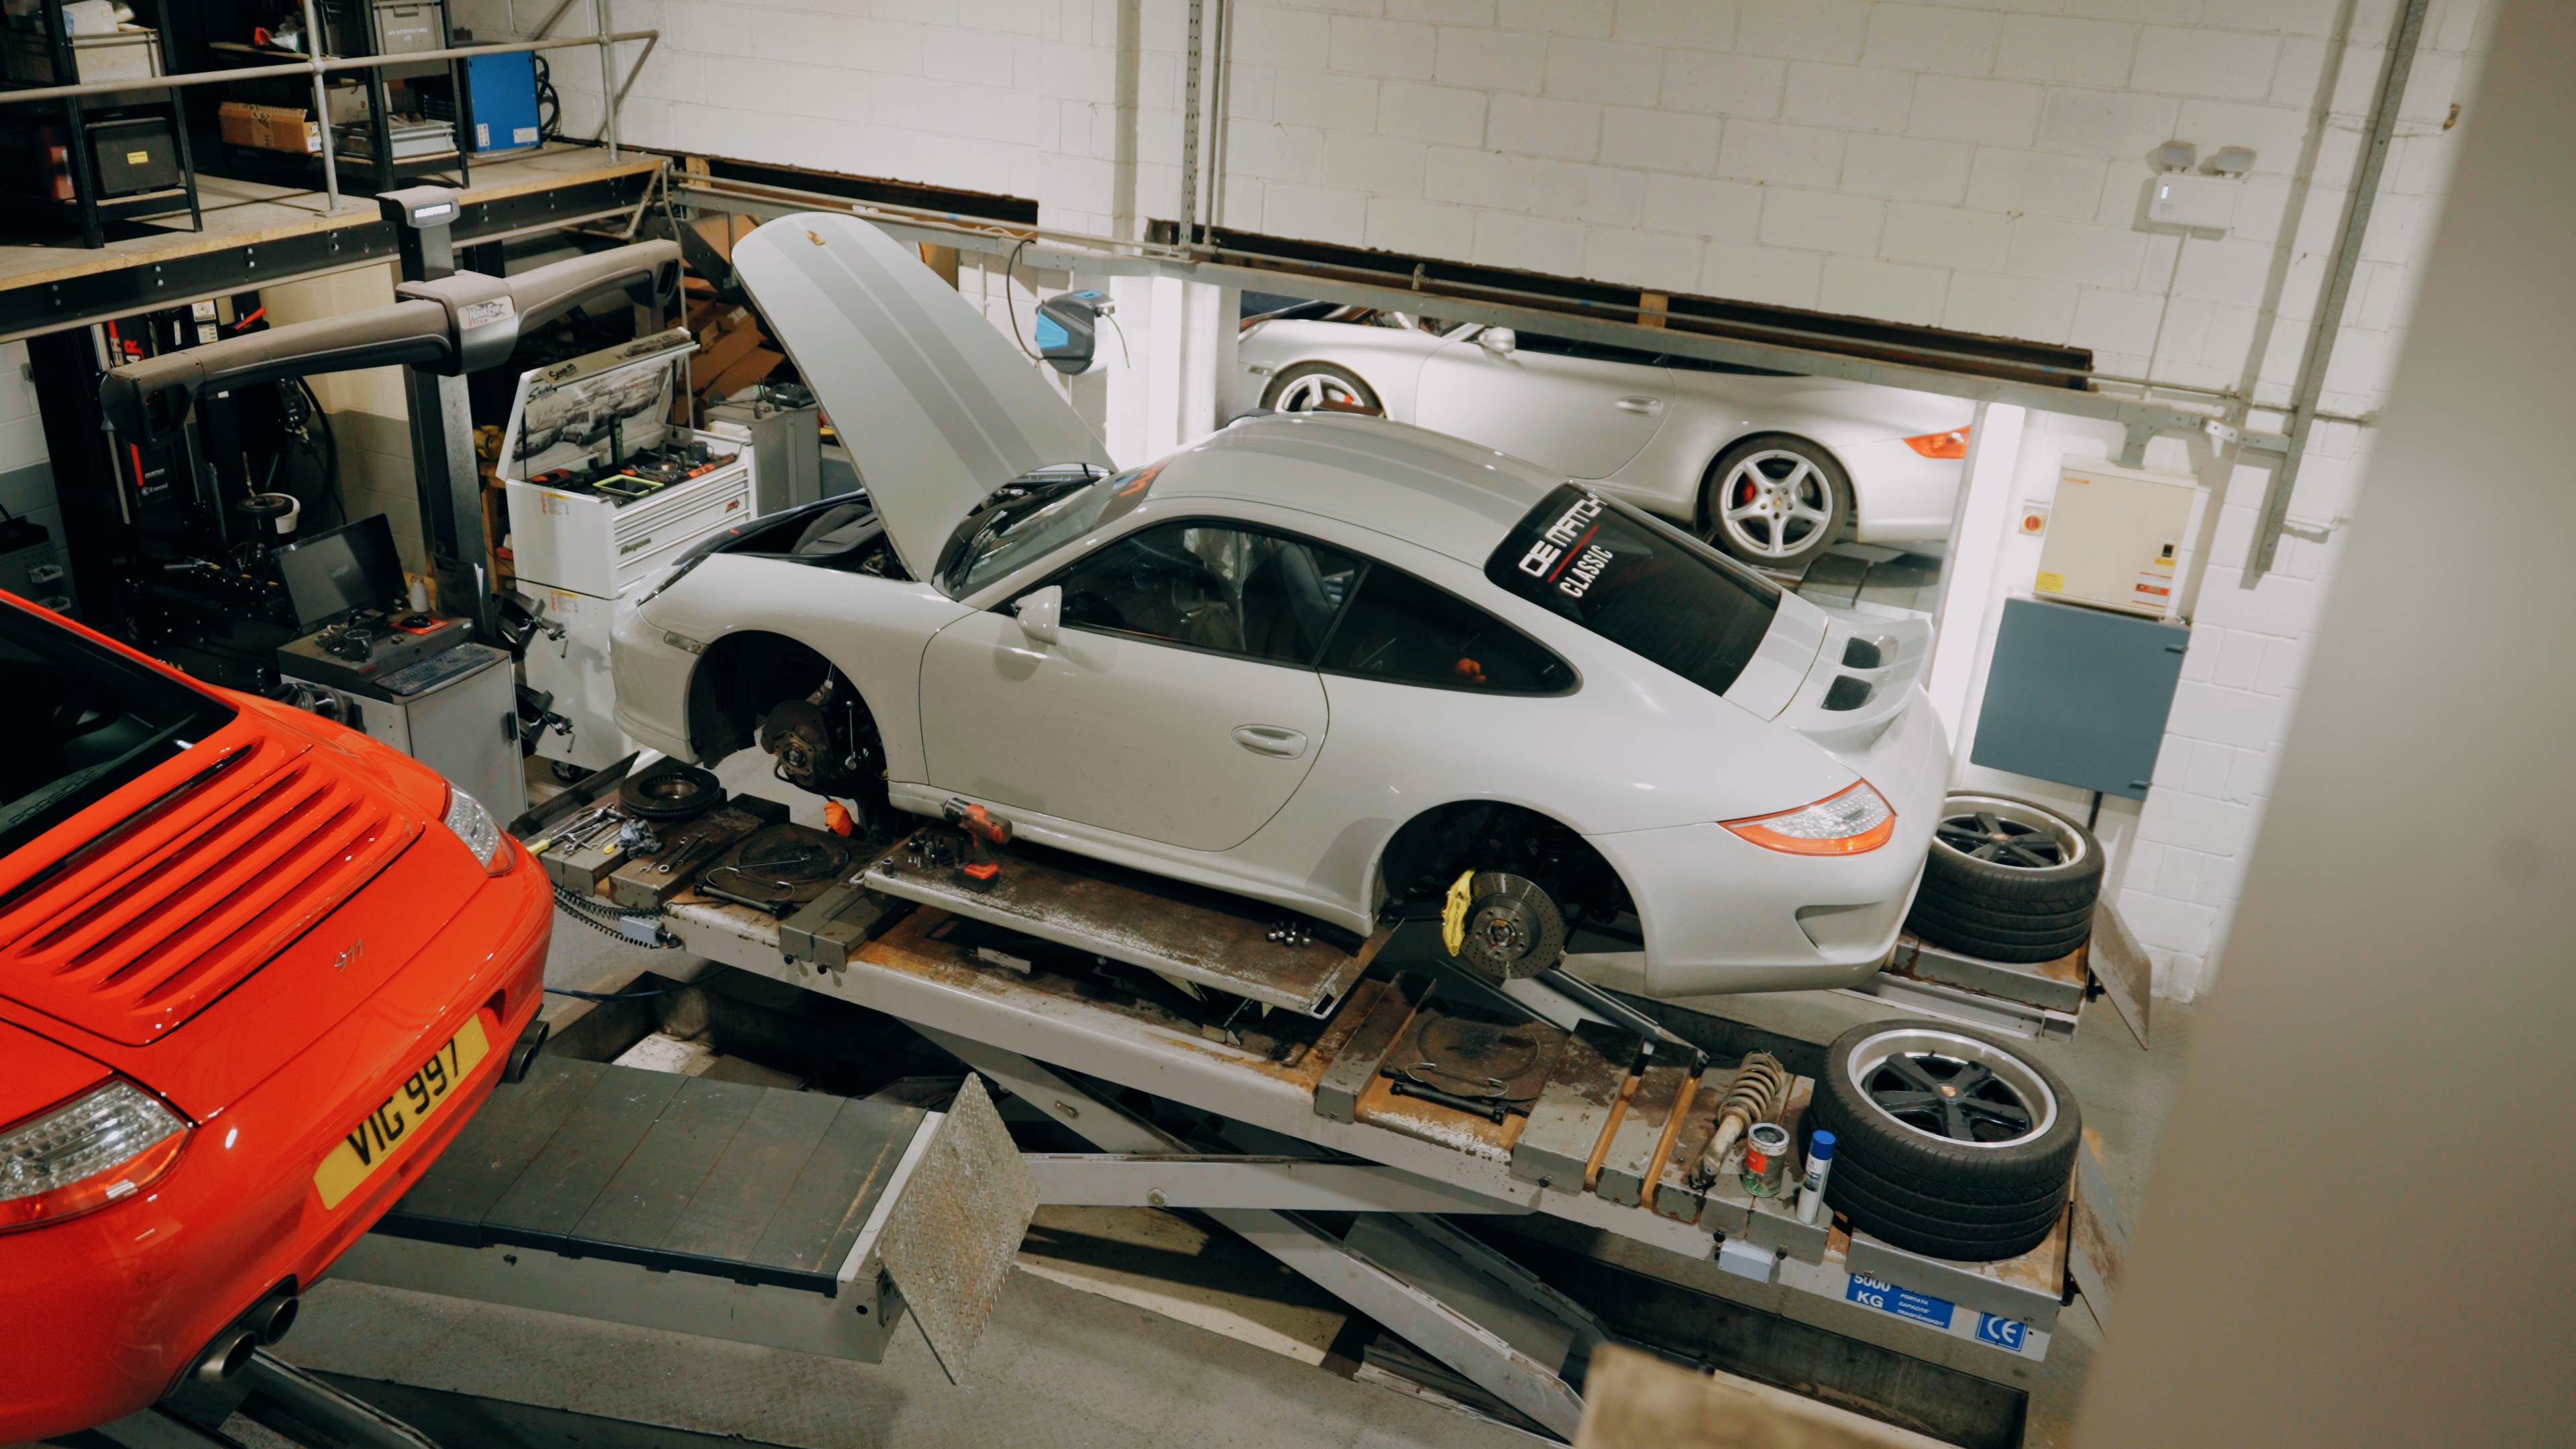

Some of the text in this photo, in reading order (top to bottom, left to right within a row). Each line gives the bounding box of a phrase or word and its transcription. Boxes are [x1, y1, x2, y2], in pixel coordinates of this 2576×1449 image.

[1518, 540, 1562, 578] OE
[1559, 545, 1613, 598] CLASSIC
[9, 770, 101, 824] PORSCHE
[333, 938, 364, 972] 911
[346, 1036, 459, 1167] VIG 997
[1854, 1274, 1891, 1292] 5000
[1856, 1290, 1884, 1309] KG
[1900, 1293, 1929, 1305] PORTATA
